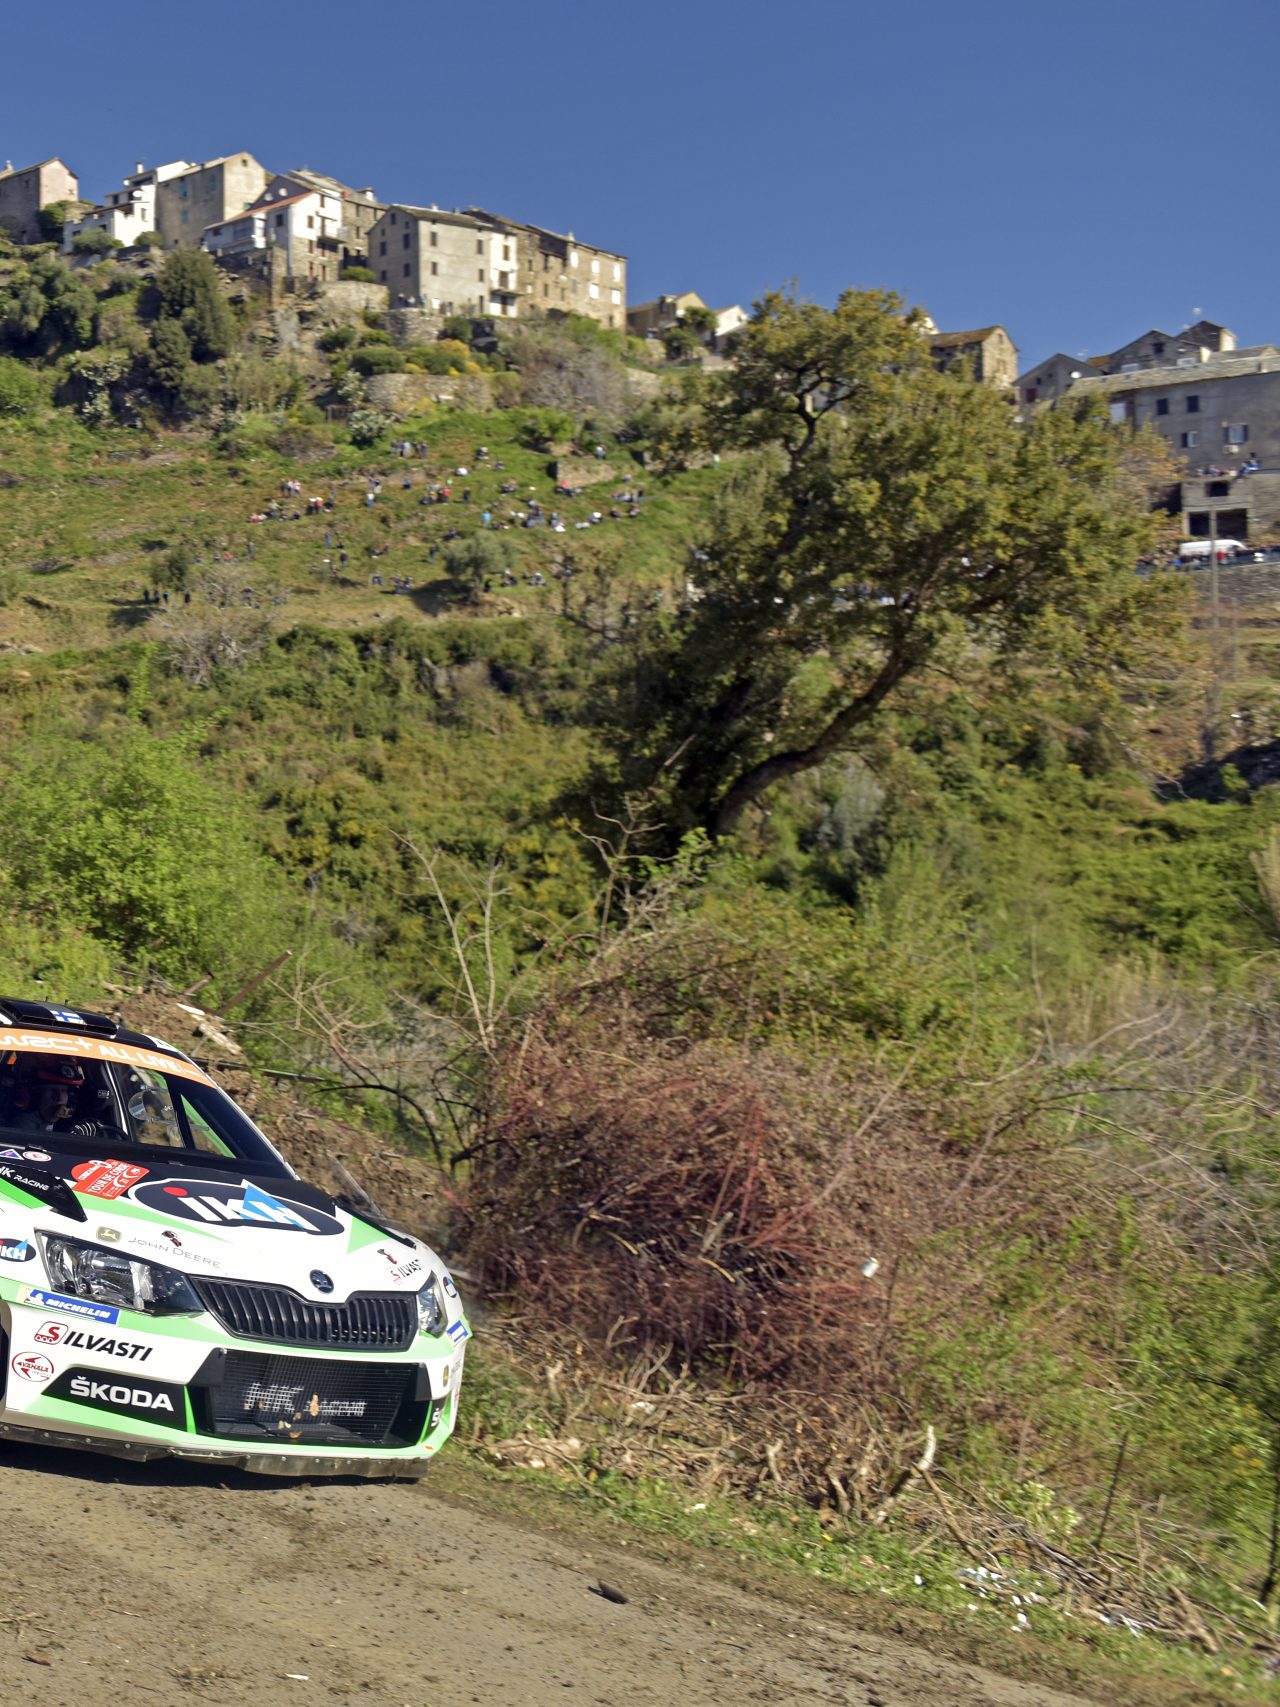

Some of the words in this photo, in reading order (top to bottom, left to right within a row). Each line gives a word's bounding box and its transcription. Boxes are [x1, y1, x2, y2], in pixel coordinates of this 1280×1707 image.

[98, 1044, 137, 1062] ALL
[137, 1052, 182, 1073] LIVE
[14, 1174, 50, 1191] RACING
[128, 1237, 169, 1252] JOHN
[173, 1247, 221, 1268] DEERE
[45, 1299, 111, 1318] MICHELIN
[48, 1326, 153, 1361] SILVASTI
[22, 1362, 49, 1373] VAHALA
[70, 1375, 174, 1412] ŠKODA
